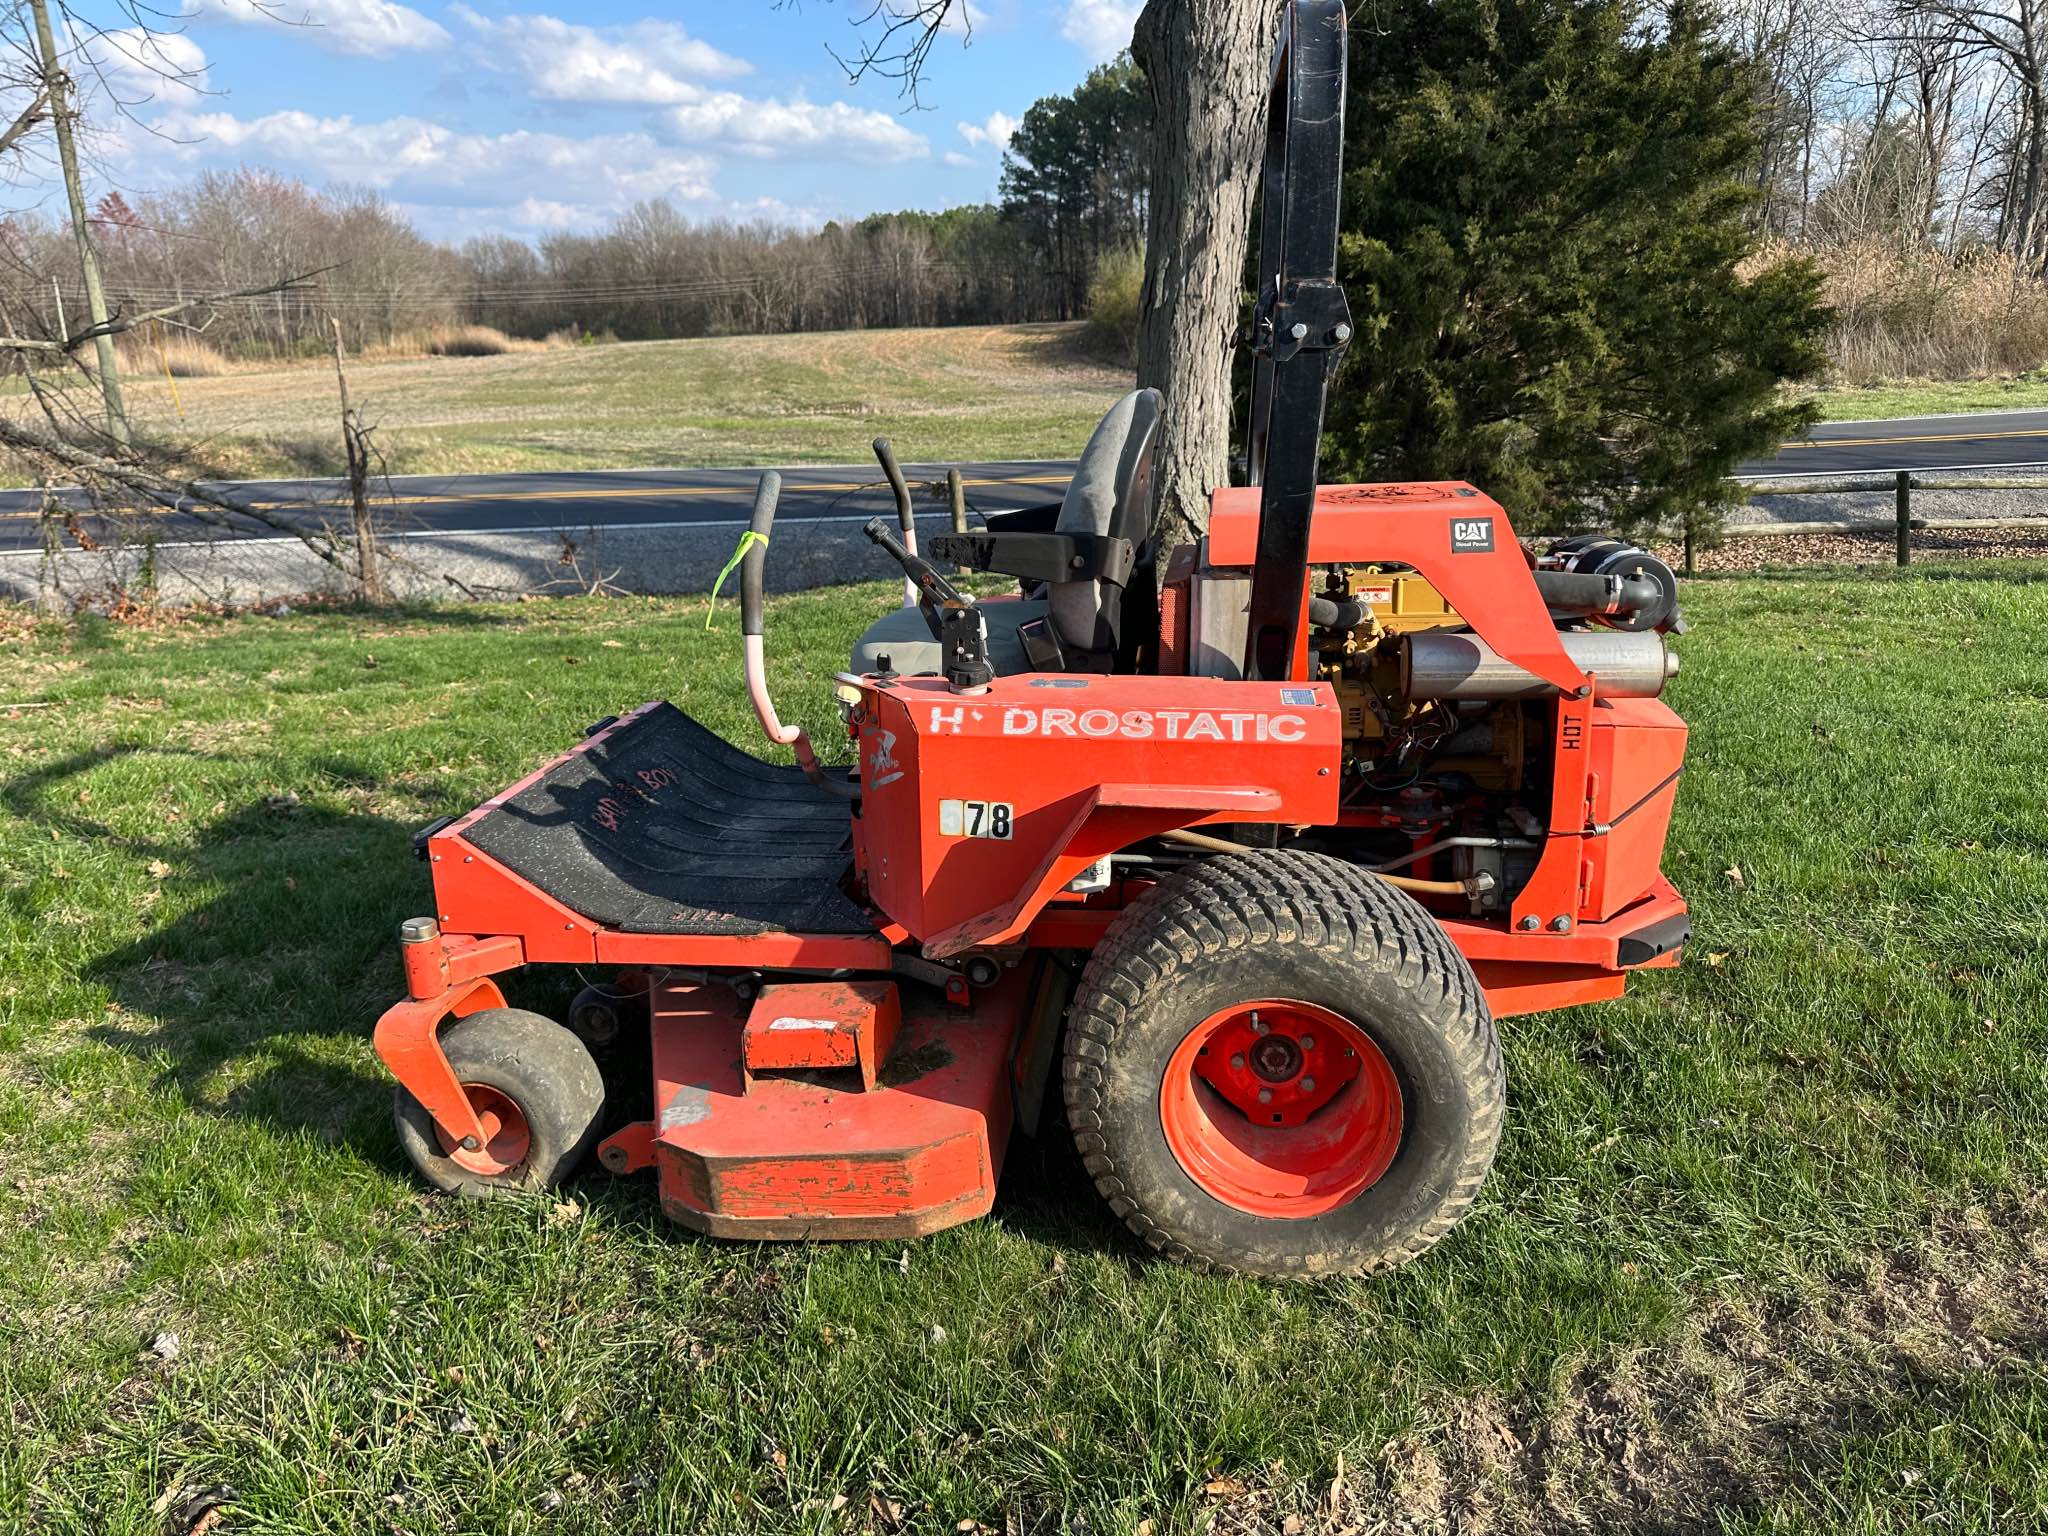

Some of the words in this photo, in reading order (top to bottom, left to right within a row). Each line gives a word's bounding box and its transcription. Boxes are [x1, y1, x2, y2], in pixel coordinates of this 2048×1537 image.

[1454, 522, 1489, 540] CAT
[930, 706, 1306, 742] HDROSTATIC
[1562, 714, 1582, 750] HOT
